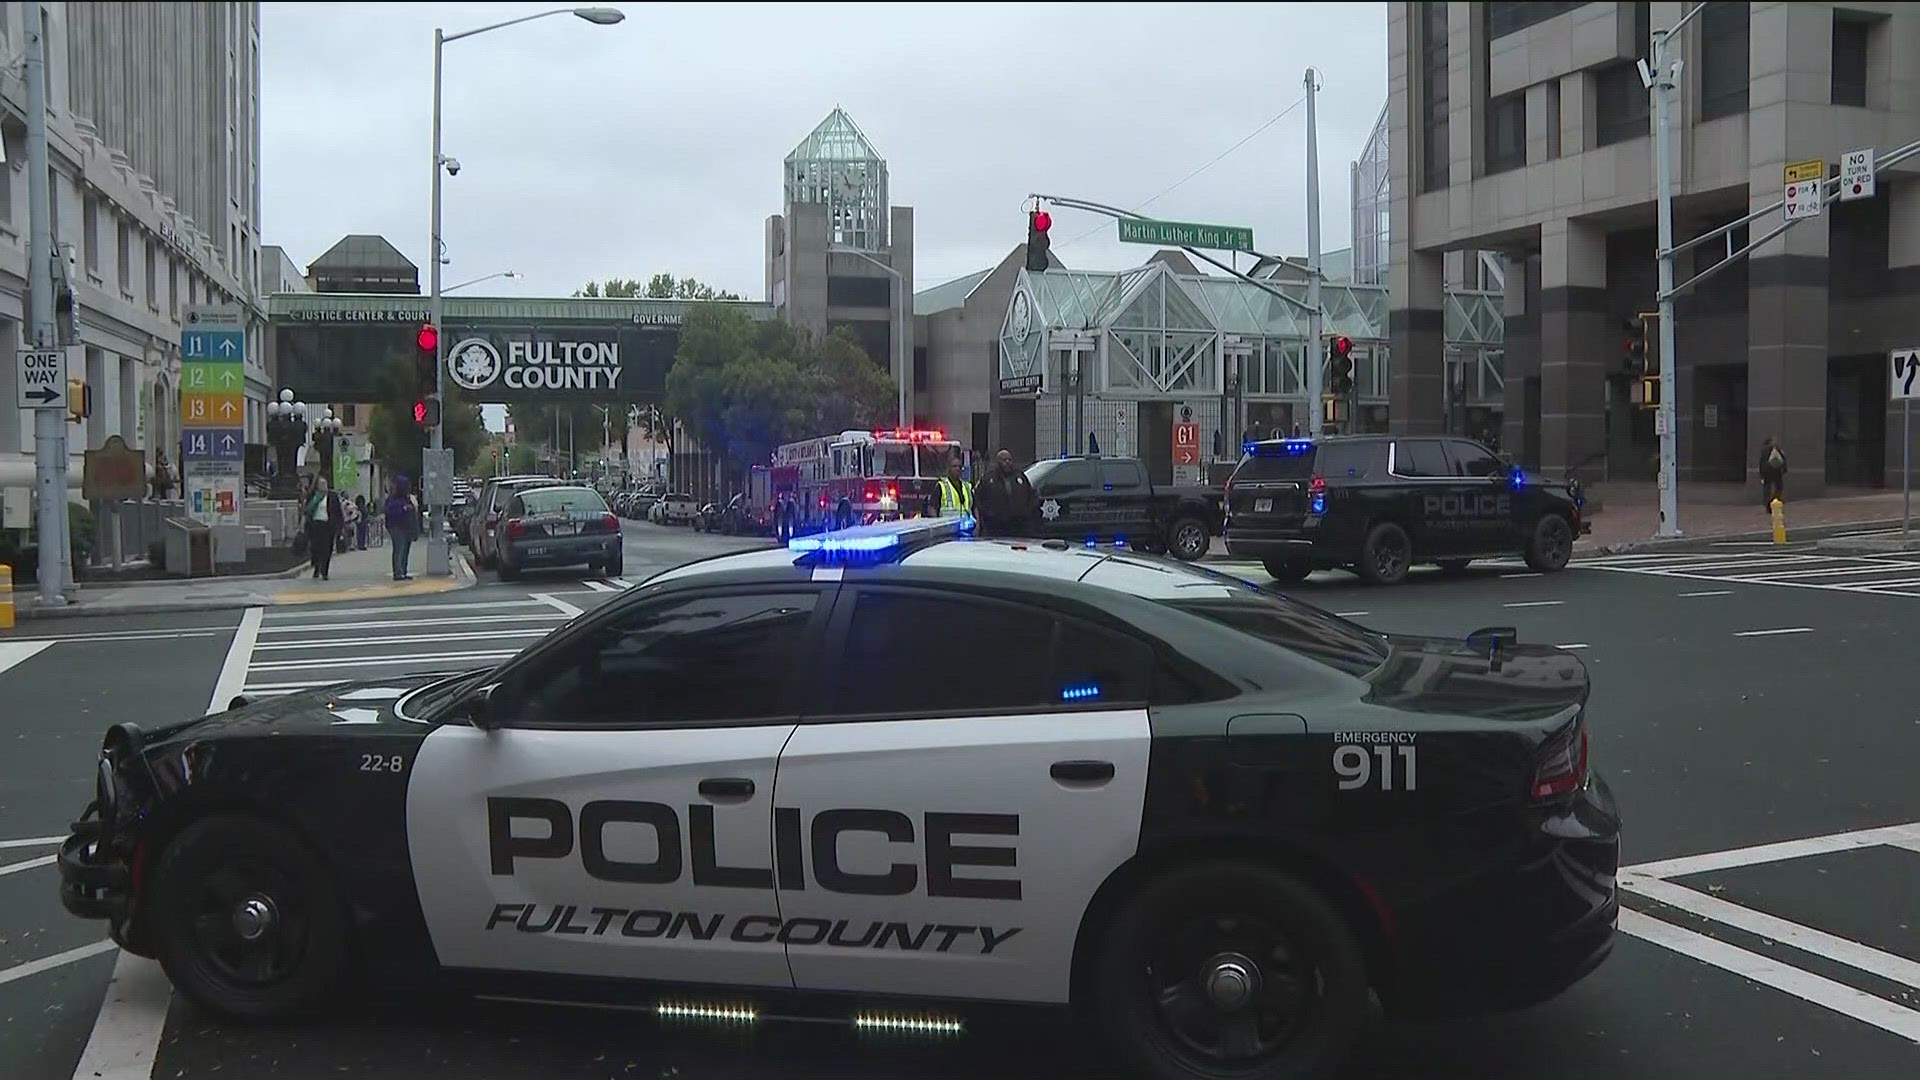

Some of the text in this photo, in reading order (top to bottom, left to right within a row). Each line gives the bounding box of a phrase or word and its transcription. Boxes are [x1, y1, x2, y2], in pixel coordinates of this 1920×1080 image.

[1850, 154, 1864, 165] NO
[1848, 165, 1867, 175] TURN
[1843, 174, 1871, 186] ON RED
[1124, 223, 1233, 248] Martin Luther King Jr
[302, 311, 341, 321] JUSTICE
[345, 311, 384, 321] CENTER
[387, 311, 395, 321] &
[633, 314, 683, 325] GOVERNME
[187, 336, 202, 356] J1
[508, 341, 618, 365] FULTON
[25, 354, 57, 368] ONE
[24, 370, 58, 384] WAY
[188, 367, 204, 389] J2
[503, 366, 623, 389] COUNTY
[189, 399, 204, 419] J3
[189, 433, 205, 454] J4
[1178, 426, 1194, 444] G1
[338, 455, 351, 473] J2
[1424, 494, 1511, 515] POLICE
[1334, 732, 1417, 743] EMERGENCY
[360, 754, 402, 773] 22-8
[1333, 745, 1416, 791] 911
[487, 796, 1022, 900] POLICE
[485, 903, 1023, 954] FULTON COUNTY
